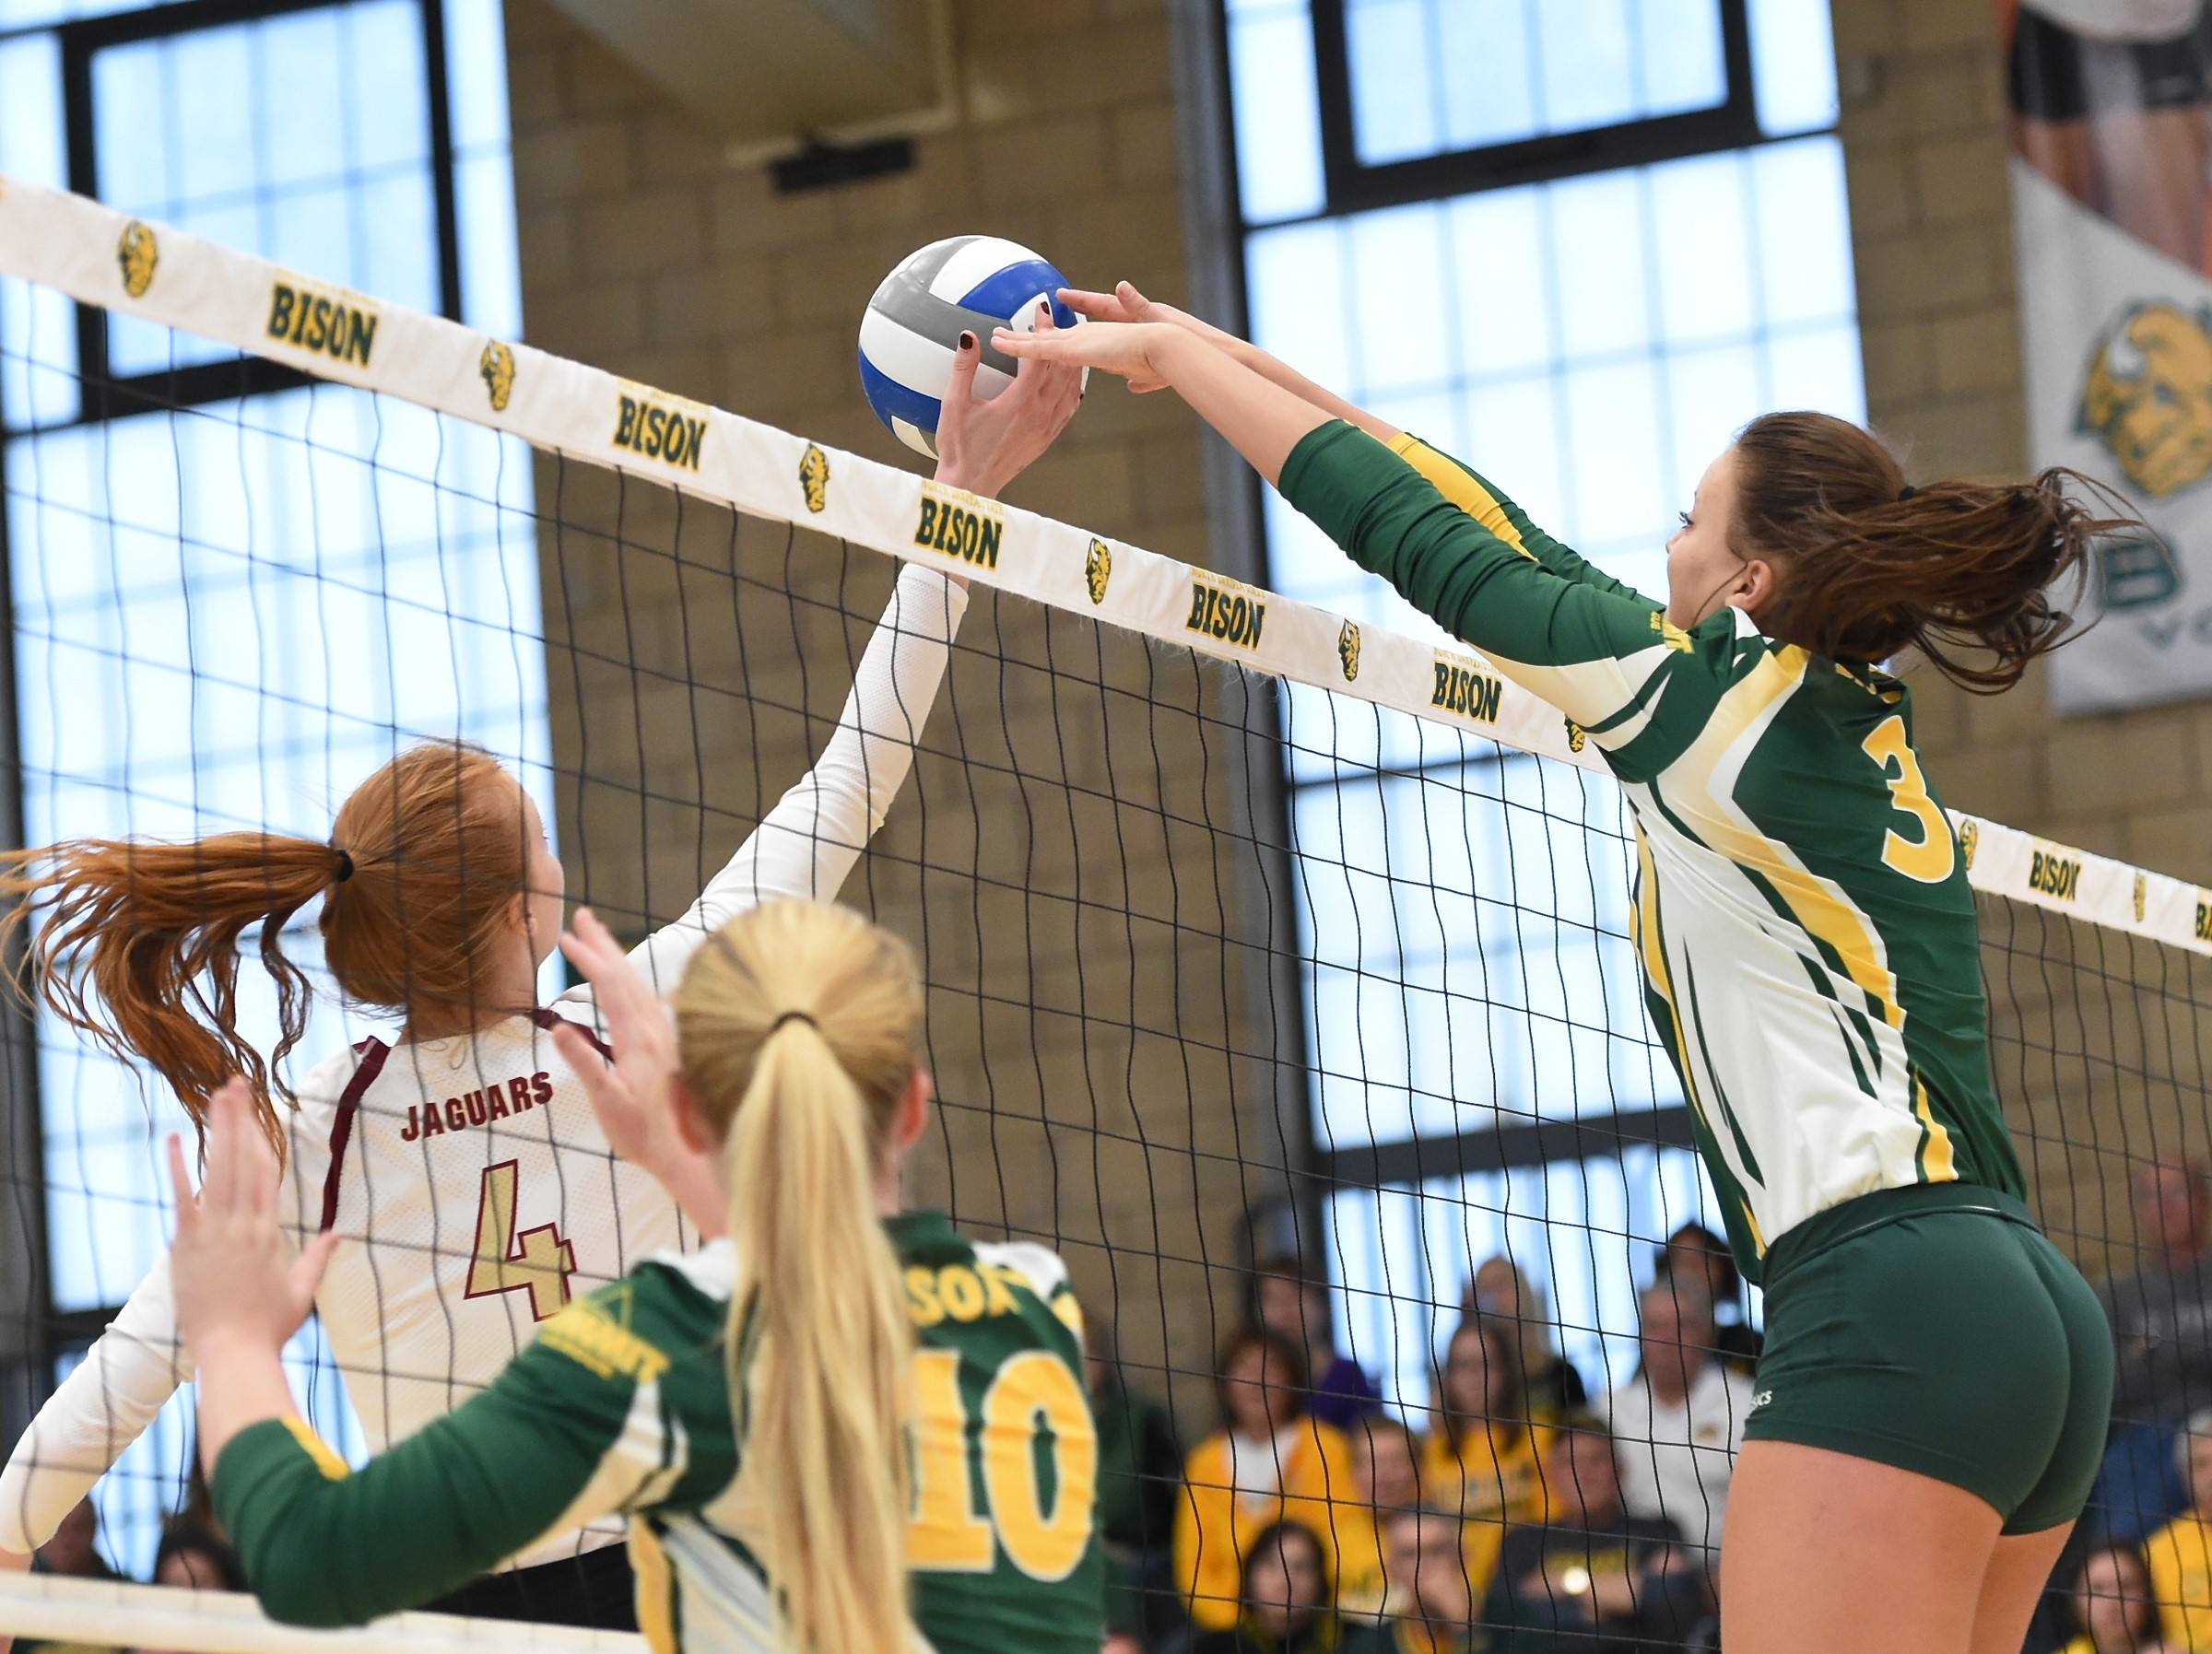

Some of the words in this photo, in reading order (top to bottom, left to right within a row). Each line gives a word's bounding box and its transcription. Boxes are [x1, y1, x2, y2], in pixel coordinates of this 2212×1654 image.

[267, 282, 378, 368] BISON
[614, 394, 707, 471] BISON
[914, 496, 1003, 569] BISON
[1185, 582, 1266, 650] BISON
[1430, 662, 1502, 724] BISON
[1861, 714, 1956, 884] 3
[2029, 850, 2081, 900] BISON
[401, 1071, 553, 1142] JAGUARS
[464, 1158, 578, 1322] 4
[901, 1348, 1100, 1583] 10
